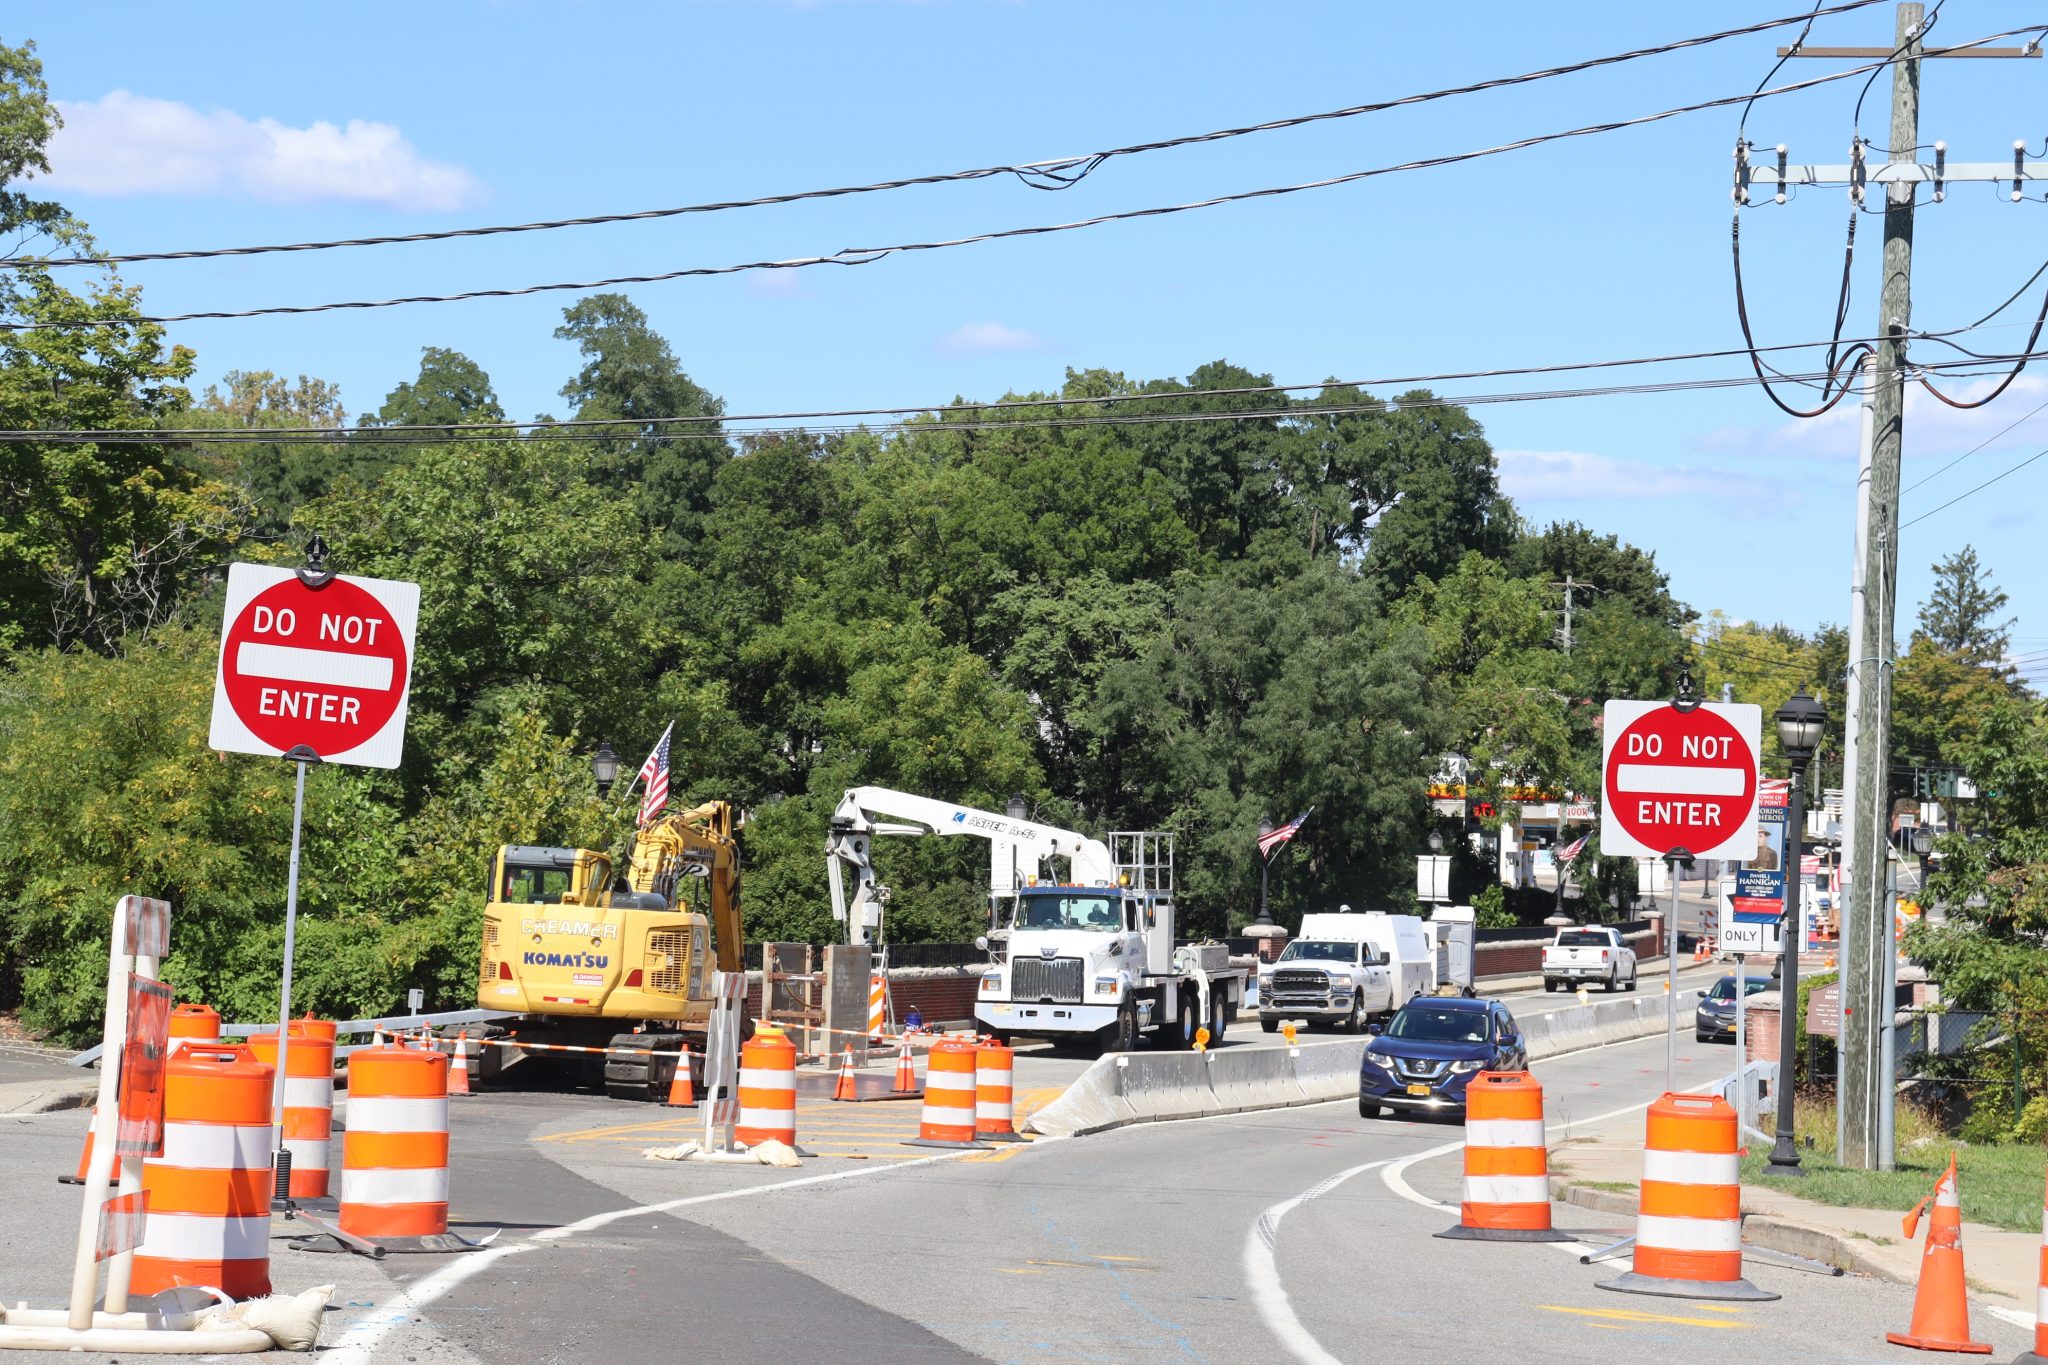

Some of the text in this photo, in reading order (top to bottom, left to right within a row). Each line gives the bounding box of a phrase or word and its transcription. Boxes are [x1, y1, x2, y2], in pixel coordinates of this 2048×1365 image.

[253, 605, 382, 645] DO NOT
[259, 688, 360, 725] ENTER
[1628, 733, 1733, 760] DO NOT
[1557, 807, 1588, 816] LQUOR
[1638, 801, 1721, 827] ENTER
[968, 817, 1037, 840] ASPEN A-52
[1739, 878, 1780, 886] HANNIGAN
[521, 919, 618, 940] CREAMER
[1725, 930, 1757, 942] ONLY
[523, 951, 609, 969] KOMATSU
